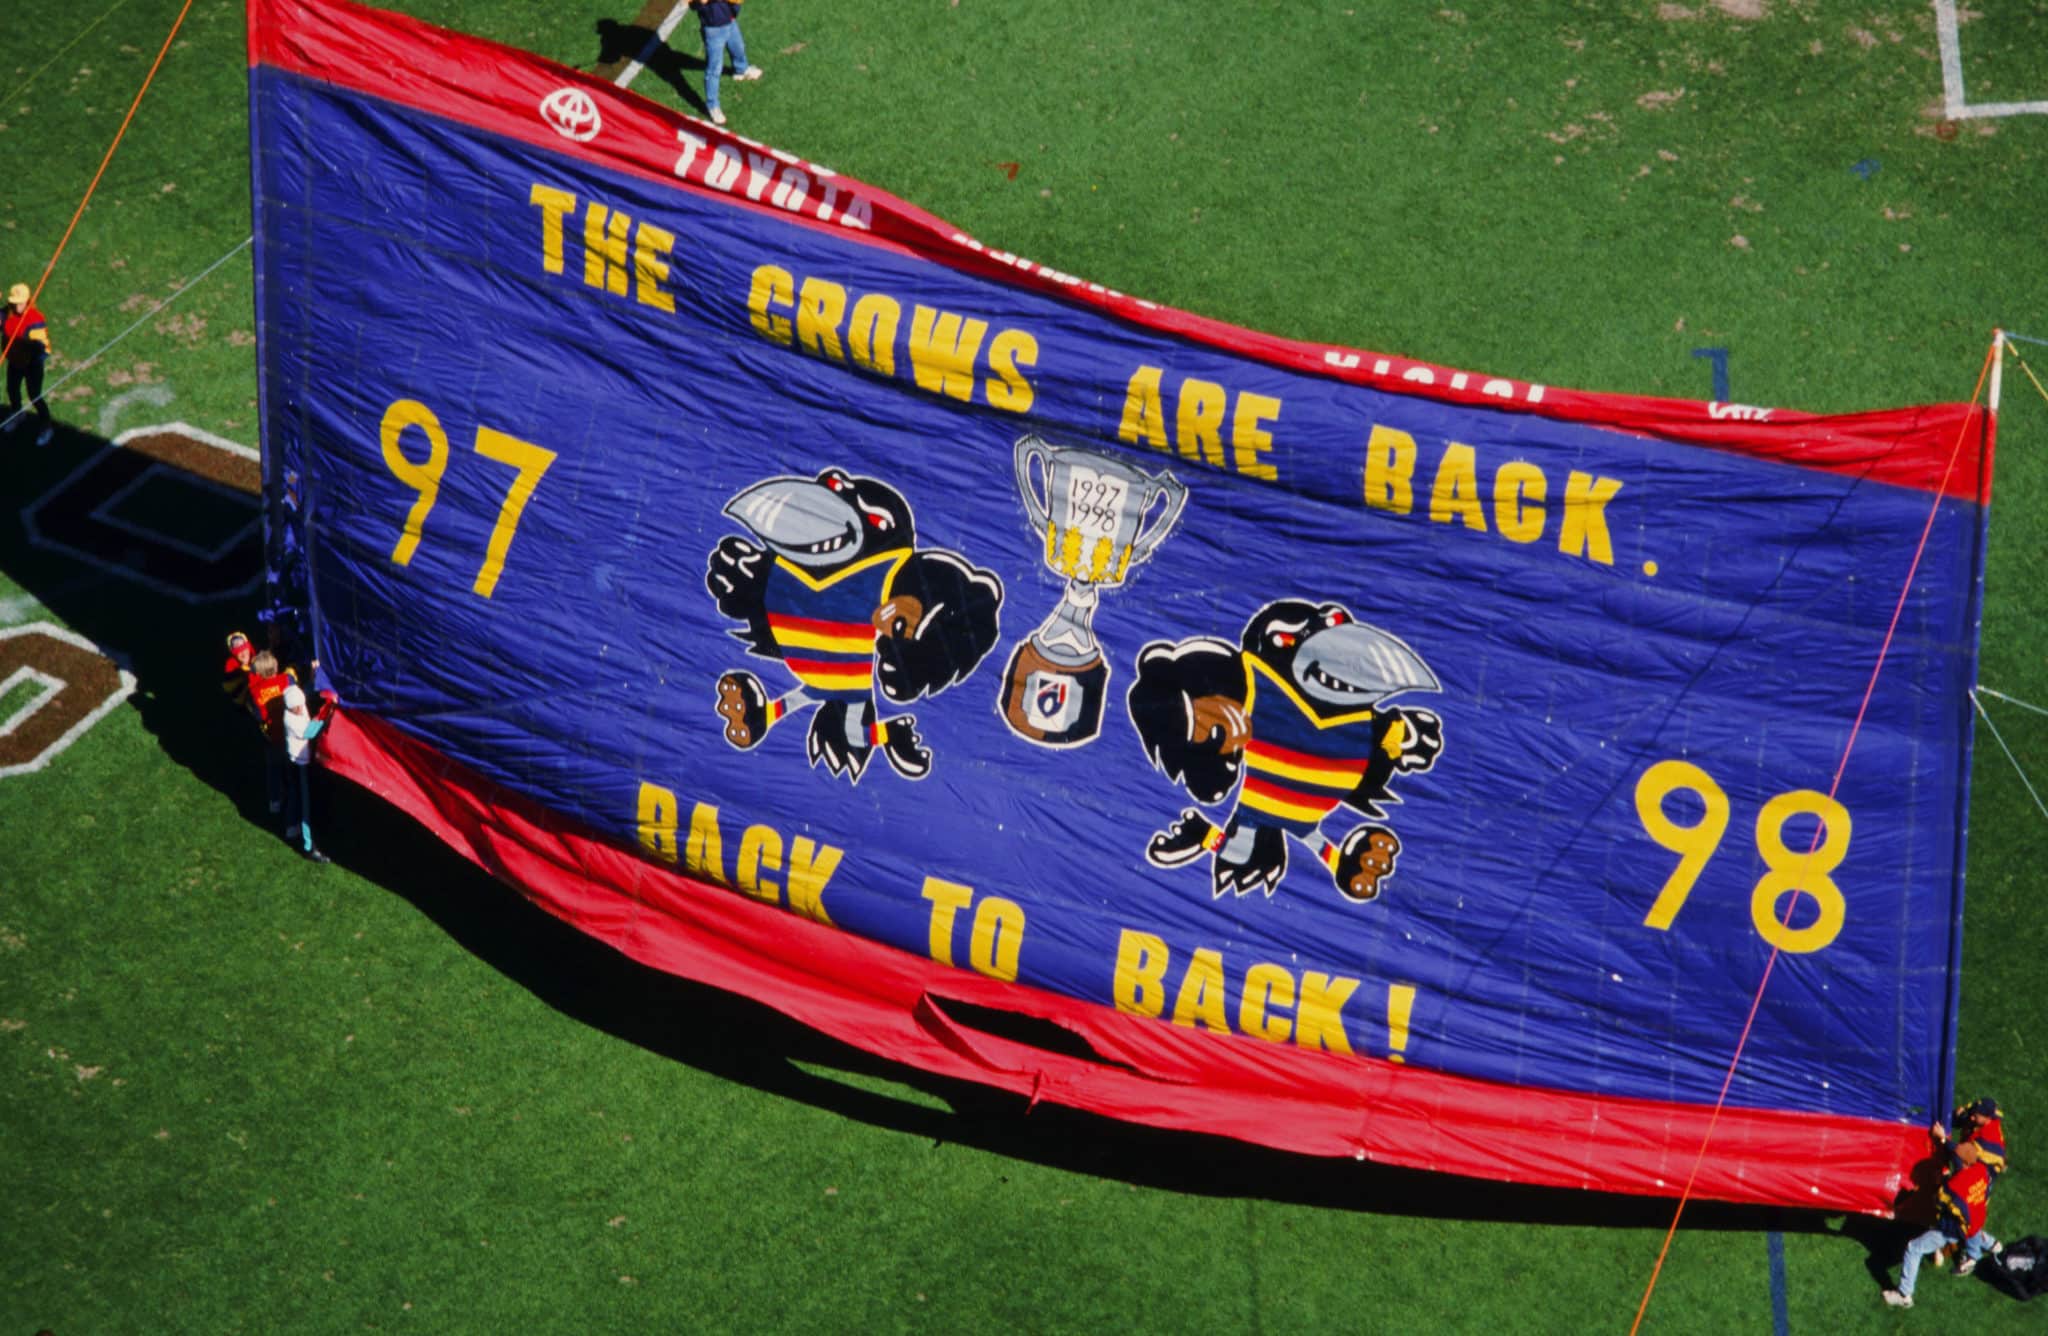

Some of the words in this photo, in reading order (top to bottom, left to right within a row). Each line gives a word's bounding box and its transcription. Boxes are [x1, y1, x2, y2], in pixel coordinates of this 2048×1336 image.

[675, 128, 874, 230] TOYOTA
[530, 183, 676, 313] THE
[747, 264, 1039, 413] CROWS
[1118, 365, 1281, 481] ARE
[380, 399, 558, 599] 97
[1071, 478, 1121, 508] 1997
[1071, 501, 1116, 533] 1998
[636, 782, 846, 928] BACK
[921, 877, 1026, 983] TO
[1635, 760, 1852, 954] 98
